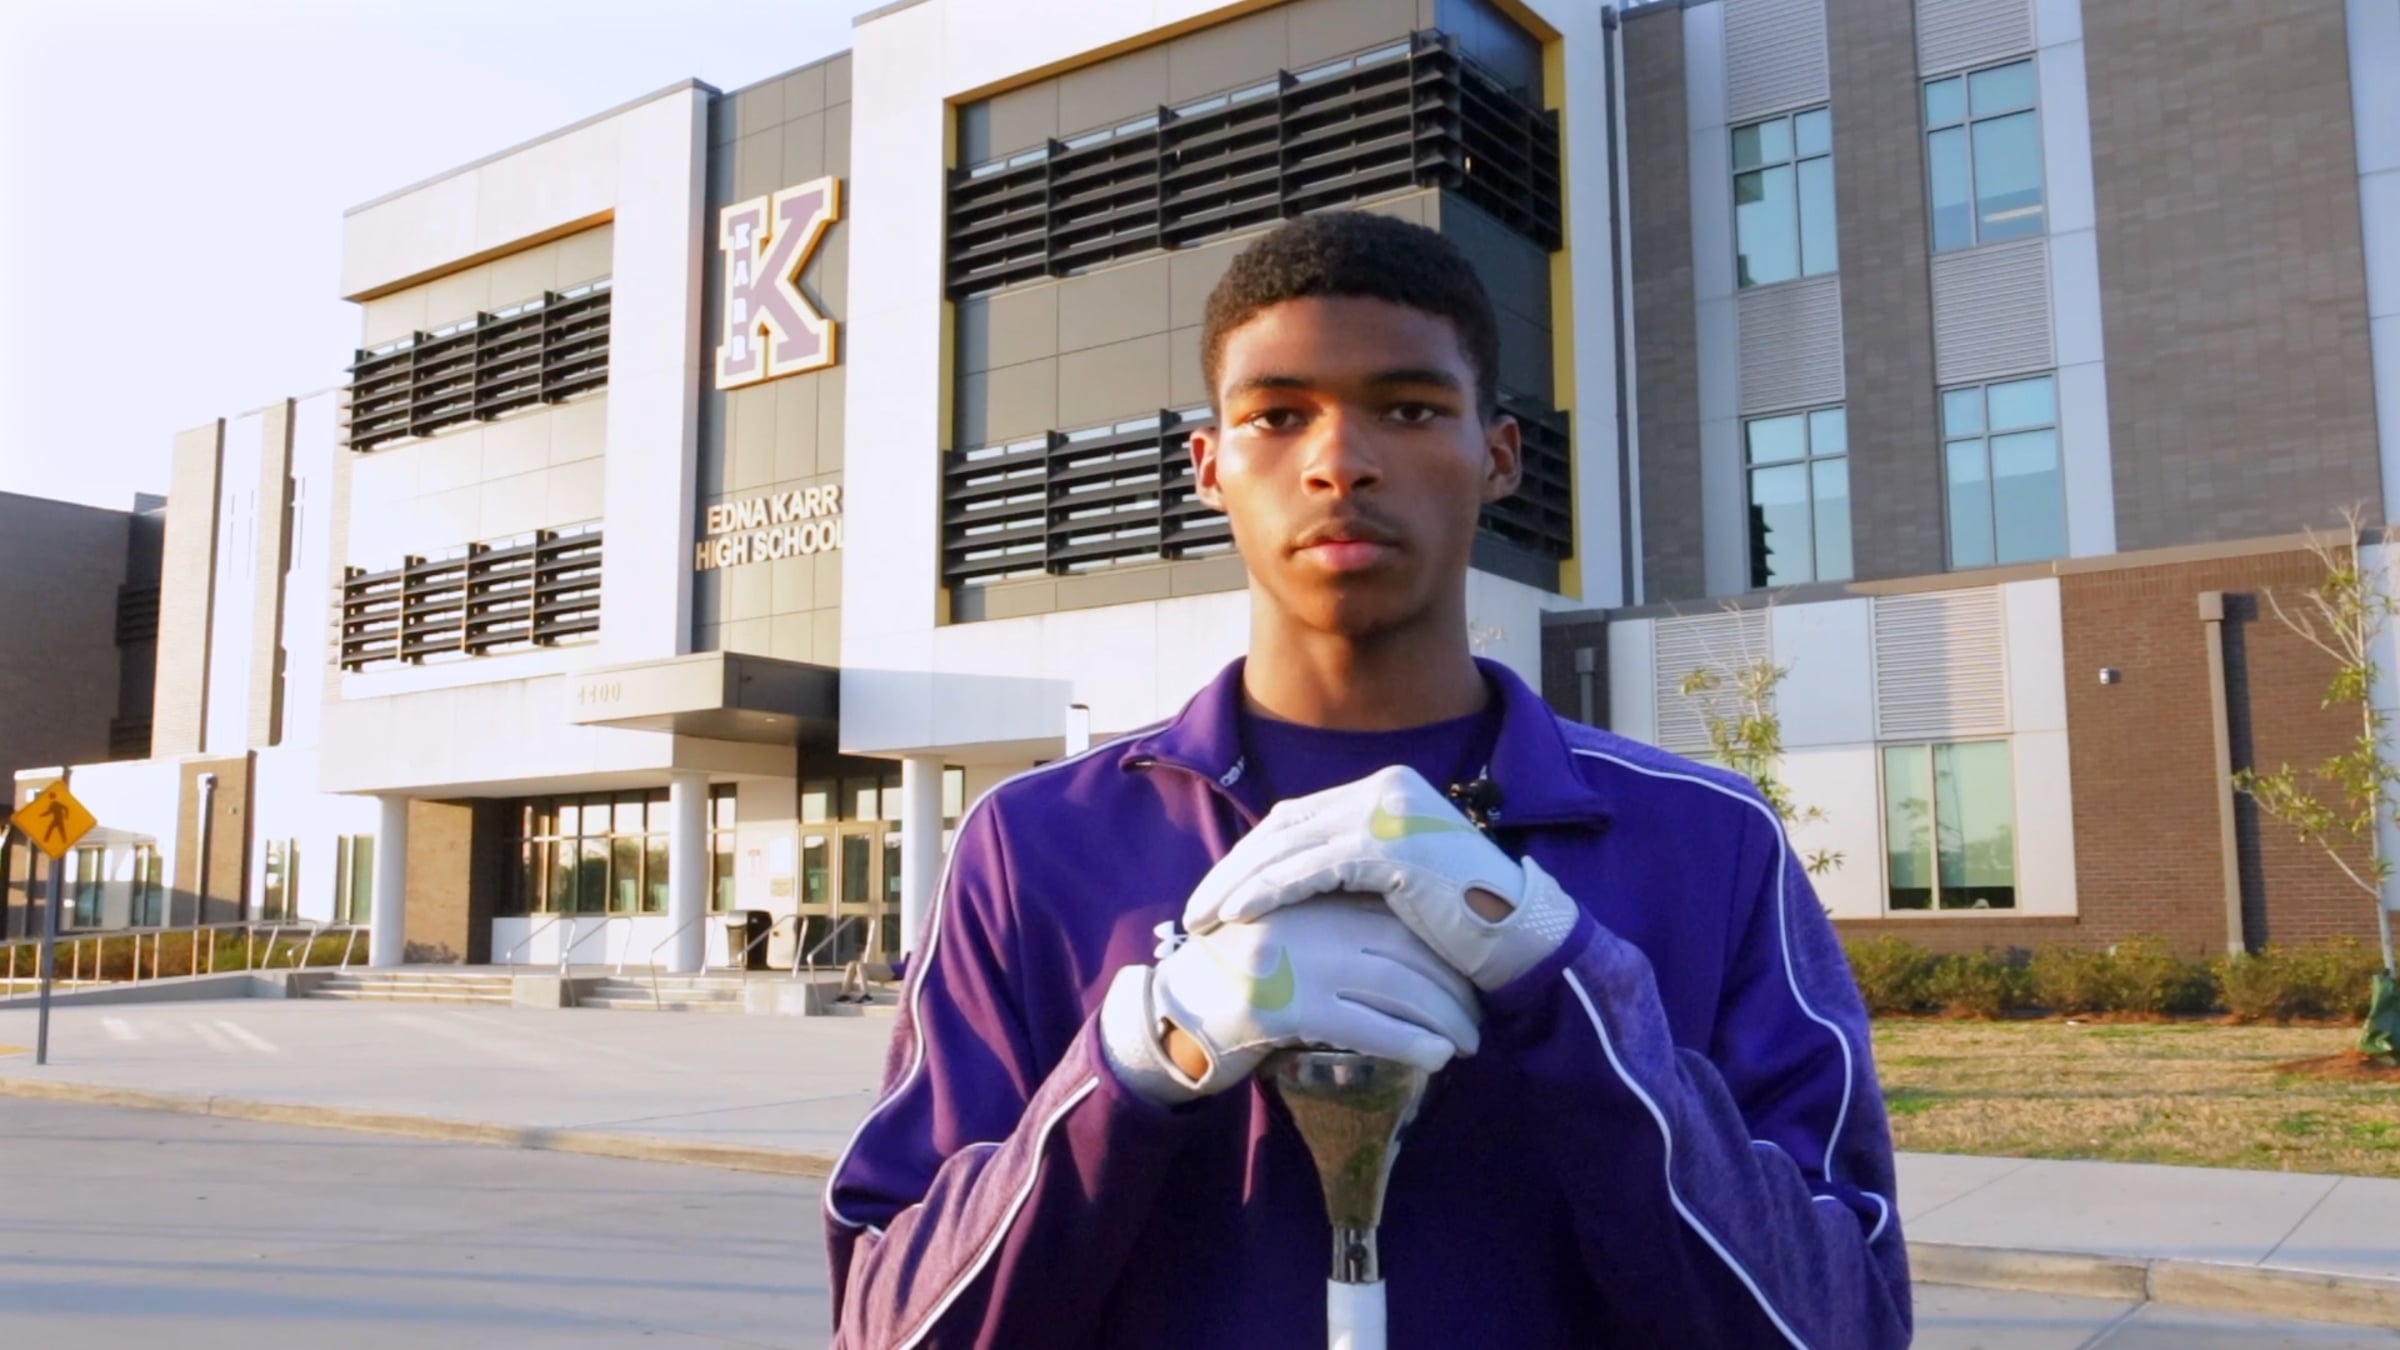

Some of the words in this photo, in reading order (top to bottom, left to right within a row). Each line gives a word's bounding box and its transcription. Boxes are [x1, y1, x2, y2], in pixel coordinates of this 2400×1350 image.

[707, 497, 768, 535] EDNA
[771, 484, 839, 524] KARR
[696, 534, 748, 571] HIGH
[752, 518, 845, 562] SCHOOL
